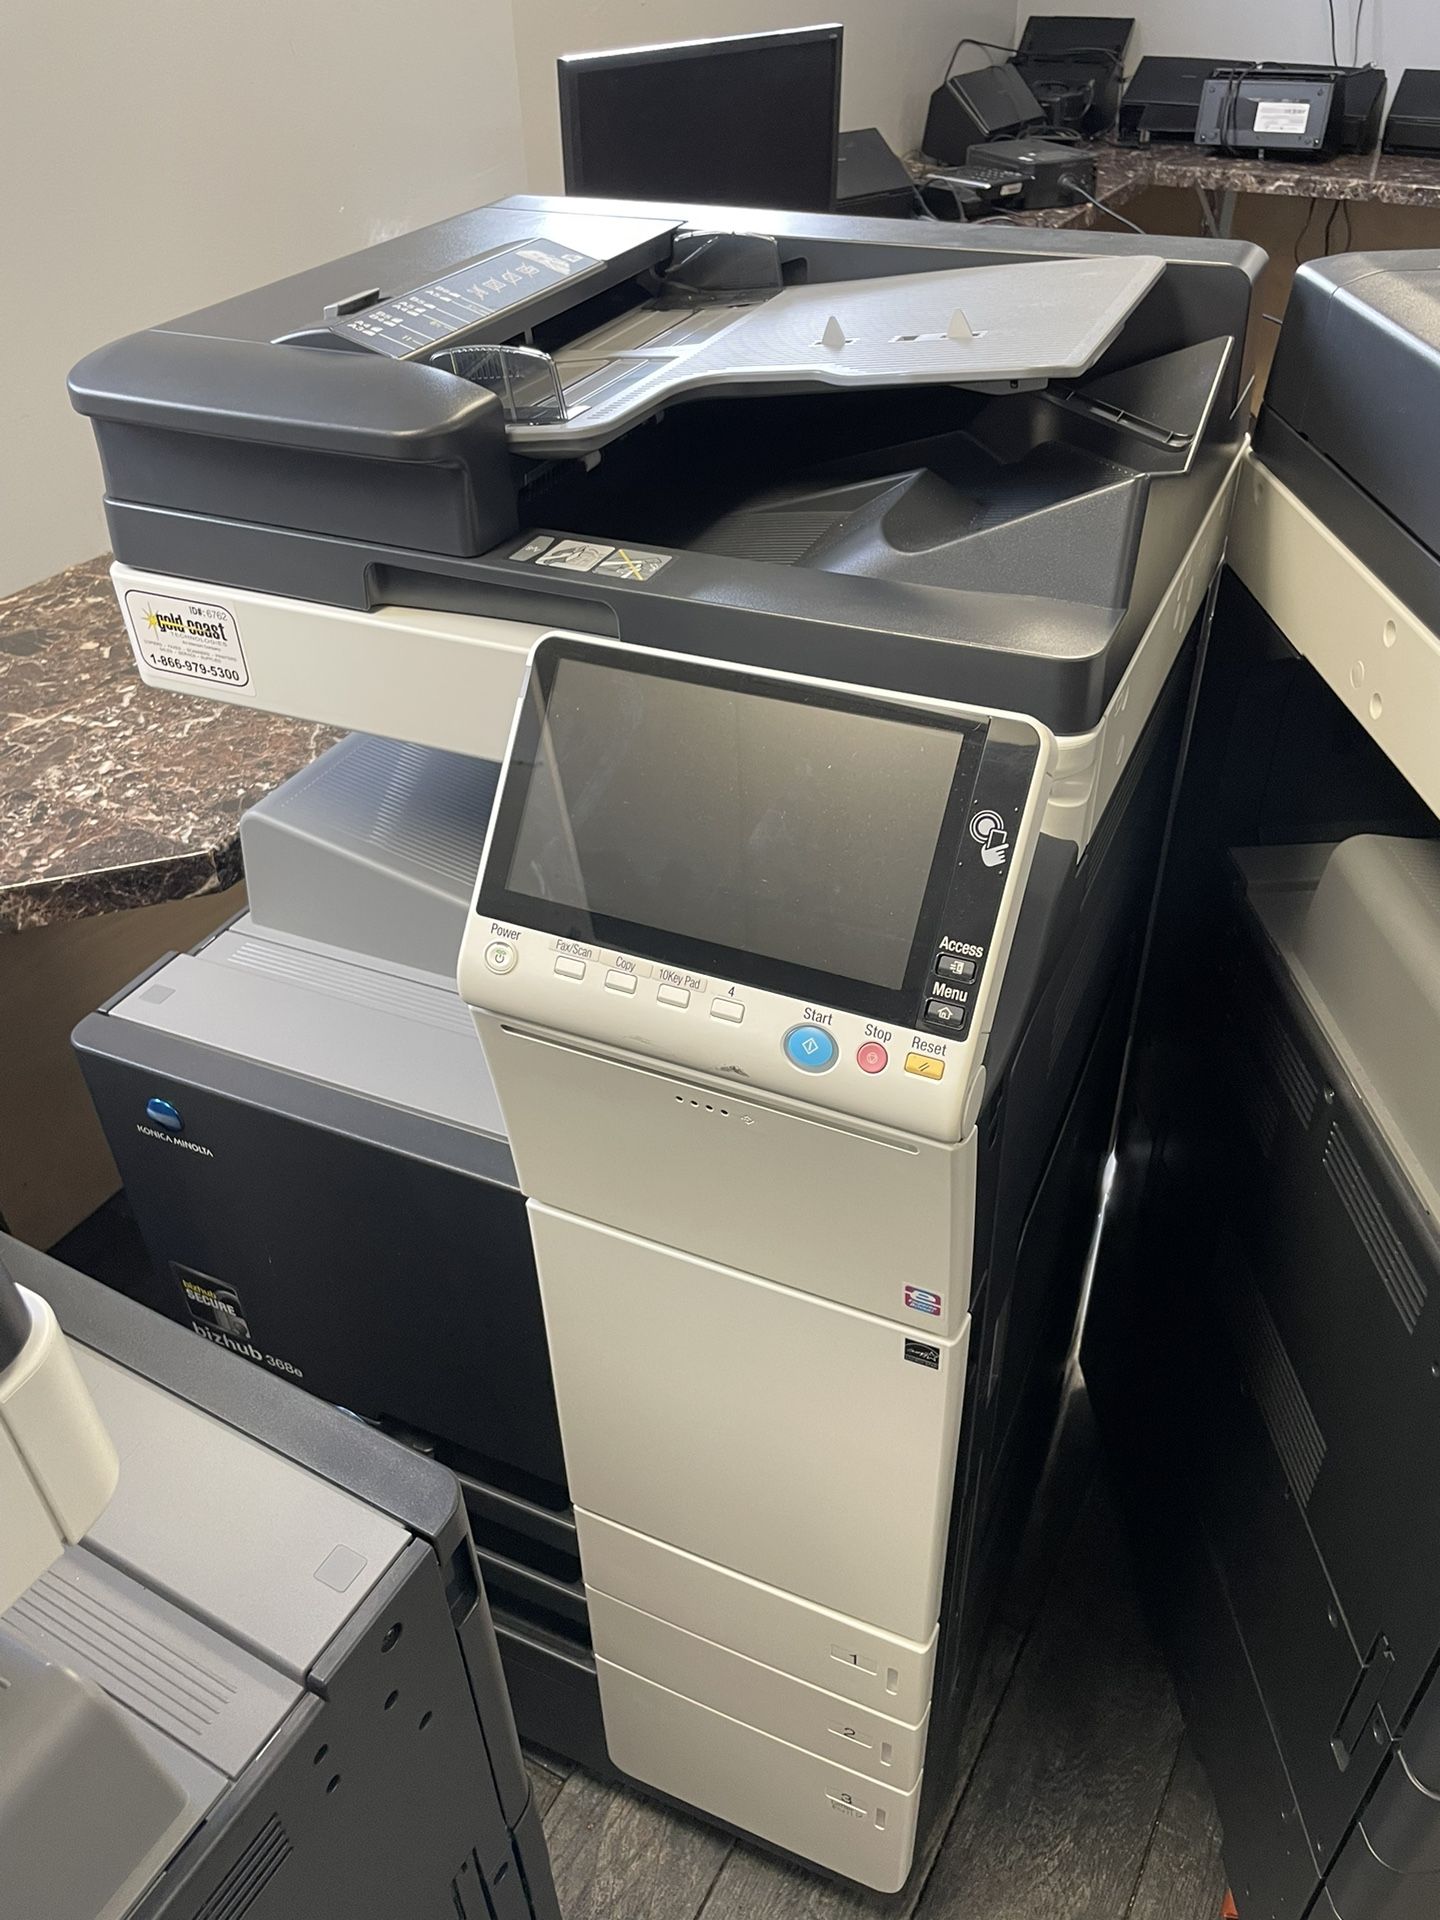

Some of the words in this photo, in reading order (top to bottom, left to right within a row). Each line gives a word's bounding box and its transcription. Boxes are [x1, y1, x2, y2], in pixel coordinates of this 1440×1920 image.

[156, 612, 185, 633] gold
[186, 619, 228, 641] coast
[150, 653, 240, 681] 1-866-979-5300
[491, 923, 522, 941] Power
[555, 939, 593, 959] Fax/Scan
[939, 935, 984, 958] Access
[615, 956, 636, 972] Copy
[684, 975, 700, 989] Pad
[727, 986, 736, 997] 4
[932, 981, 968, 1002] Menu
[803, 1007, 833, 1026] Start
[864, 1023, 892, 1043] Stop
[911, 1036, 947, 1056] Reset
[136, 1124, 173, 1143] KONICA
[173, 1137, 214, 1158] MINOLTA
[186, 1288, 237, 1317] SECURE
[192, 1321, 262, 1361] bizhub
[848, 1653, 858, 1666] 1
[843, 1727, 856, 1738] 2
[841, 1793, 852, 1805] 3
